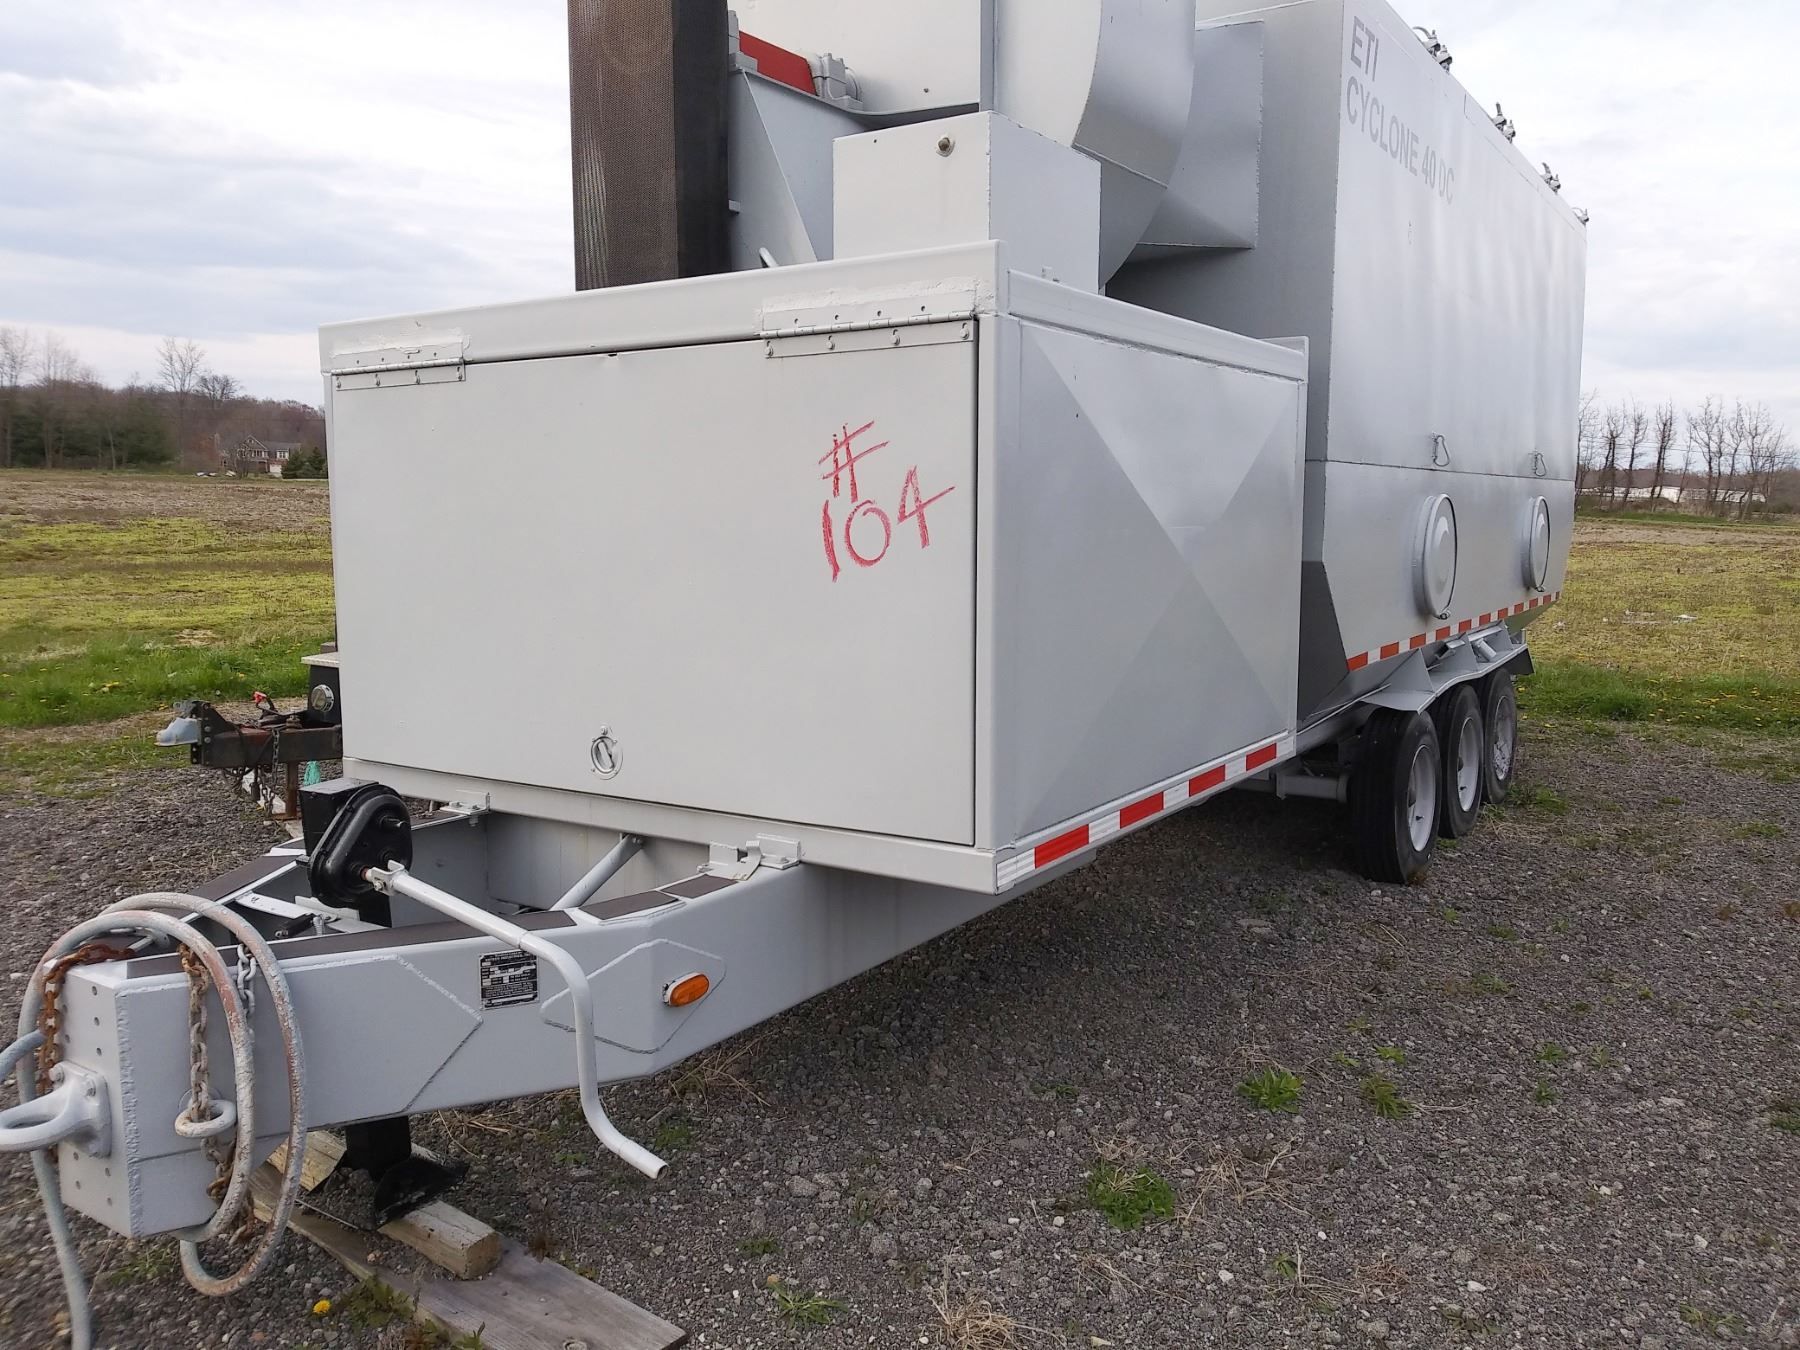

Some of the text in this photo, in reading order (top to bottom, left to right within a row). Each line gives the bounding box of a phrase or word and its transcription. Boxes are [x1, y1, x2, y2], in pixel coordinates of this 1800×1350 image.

[1350, 15, 1379, 82] ETI
[1347, 76, 1455, 205] CYCLONE 40 DC
[818, 420, 890, 504] #
[822, 465, 955, 583] 104
